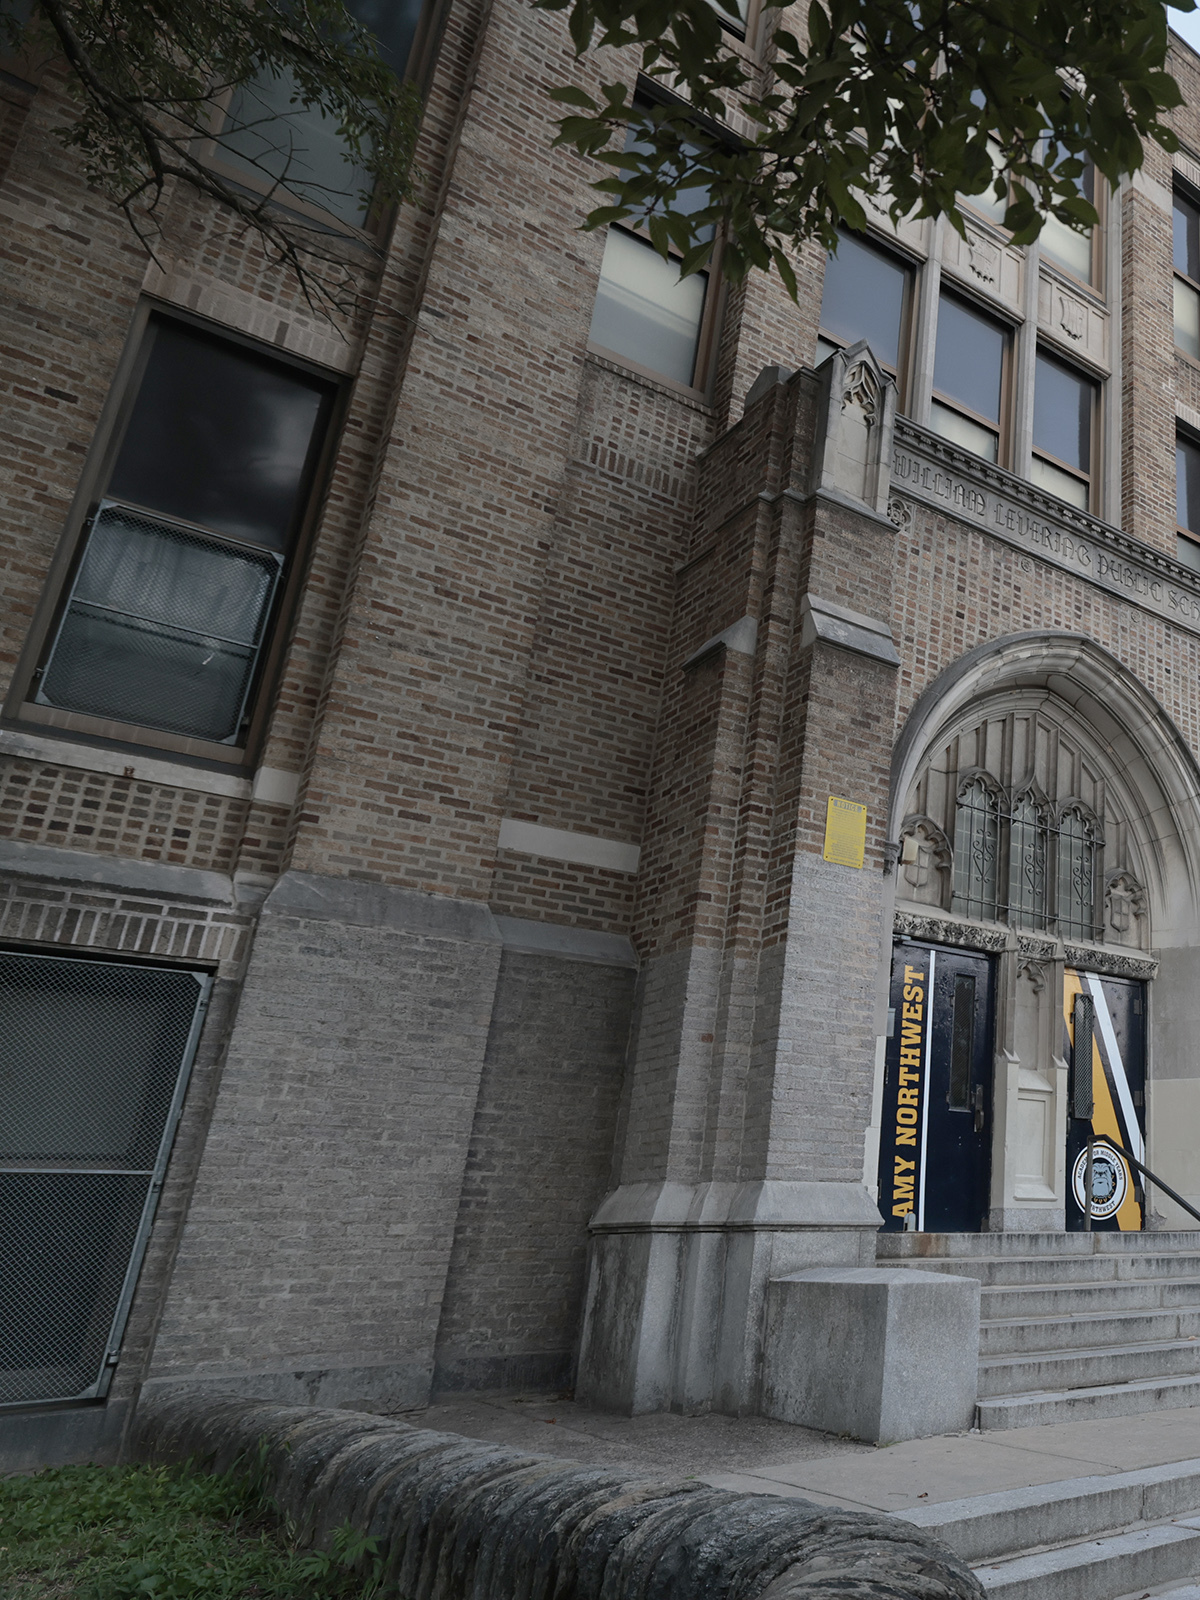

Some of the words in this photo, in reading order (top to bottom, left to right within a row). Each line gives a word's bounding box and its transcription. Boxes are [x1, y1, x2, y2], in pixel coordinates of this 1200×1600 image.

[892, 449, 985, 517] WILLIAM
[993, 503, 1092, 567] LEVERING
[1097, 553, 1162, 602] PUBLIC
[837, 800, 858, 812] NOTICE
[895, 965, 925, 1147] NORTHWEST
[892, 1155, 916, 1219] AMY
[1077, 1156, 1088, 1180] ACADE
[1100, 1150, 1116, 1163] MIDDLE
[1115, 1162, 1123, 1180] YEARS
[1091, 1200, 1115, 1213] RTHWEST
